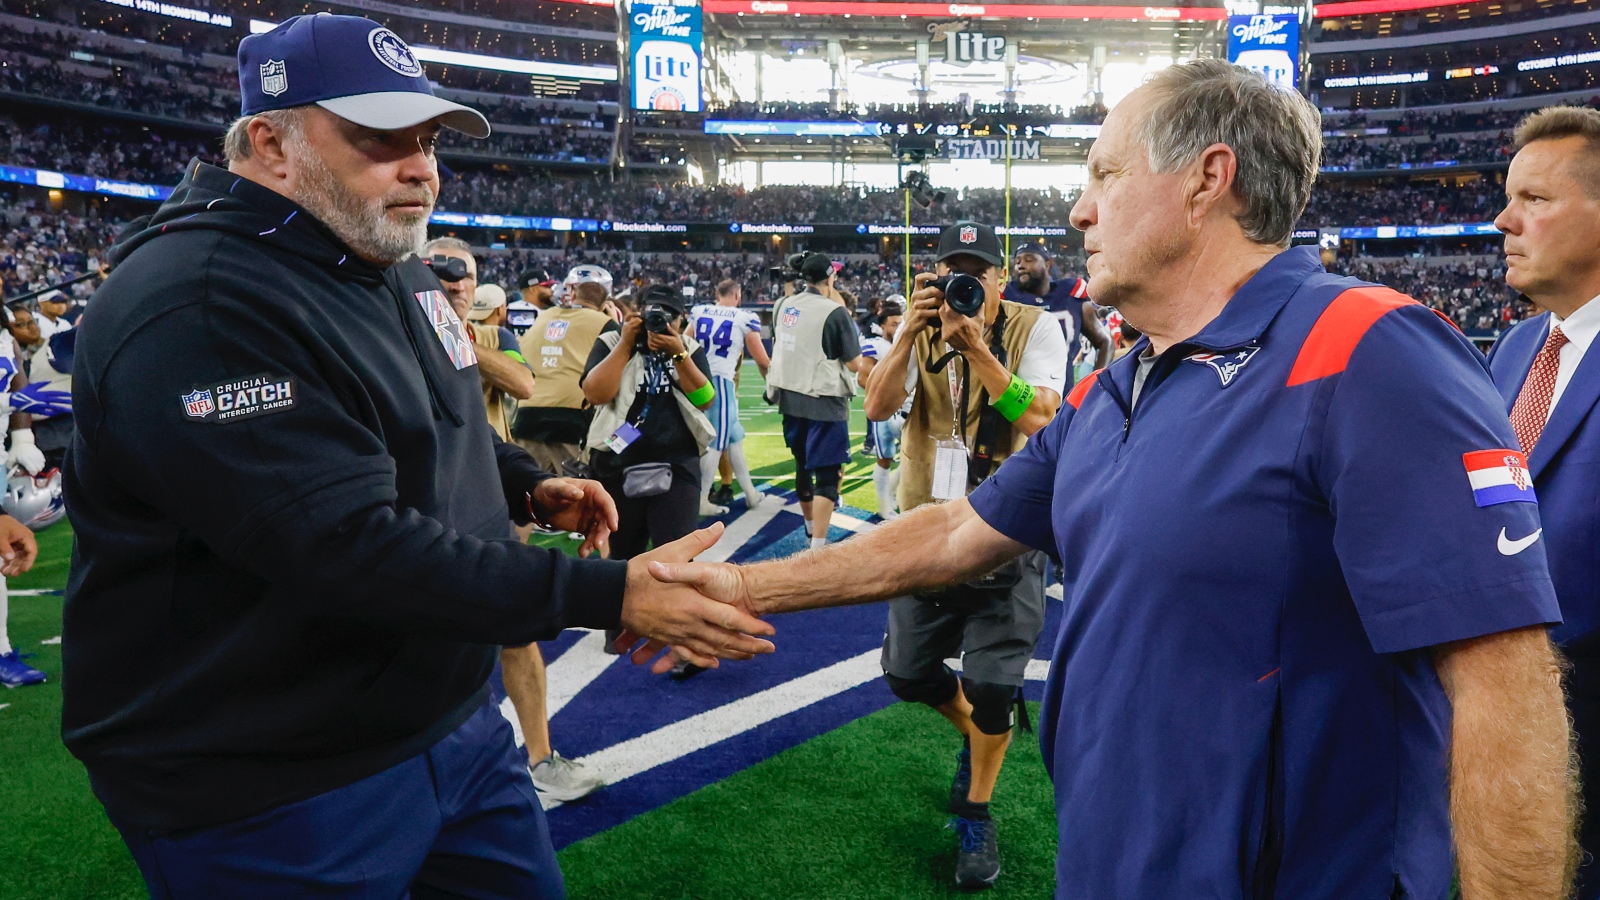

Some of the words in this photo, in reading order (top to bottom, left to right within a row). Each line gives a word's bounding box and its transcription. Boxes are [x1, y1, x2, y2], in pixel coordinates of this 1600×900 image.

[751, 1, 788, 13] Optum
[949, 4, 985, 16] Optum
[1144, 7, 1180, 19] Optum
[634, 13, 691, 32] Miller
[662, 26, 691, 37] TIME
[1233, 20, 1288, 43] Miller
[1259, 34, 1288, 44] TIME
[942, 31, 1005, 68] Lite
[645, 55, 690, 82] Lite
[1518, 58, 1557, 71] OCTOBER
[1557, 54, 1577, 66] 14TH
[1324, 77, 1359, 88] OCTOBER
[1377, 73, 1412, 84] MONSTER
[947, 139, 1040, 160] STADIUM
[613, 222, 687, 232] Blockchain.com
[741, 223, 814, 233] Blockchain.com
[868, 225, 940, 234] Blockchain.com
[995, 226, 1066, 235] Blockchain.com
[961, 232, 976, 241] NFL
[784, 314, 798, 326] NFL
[547, 328, 564, 338] NFL
[696, 317, 733, 358] 84
[542, 357, 558, 368] 242
[216, 377, 270, 394] CRUCIAL
[218, 381, 293, 412] CATCH
[188, 401, 212, 414] NFL
[218, 405, 259, 420] INTERCEPT
[263, 399, 293, 410] CANCER
